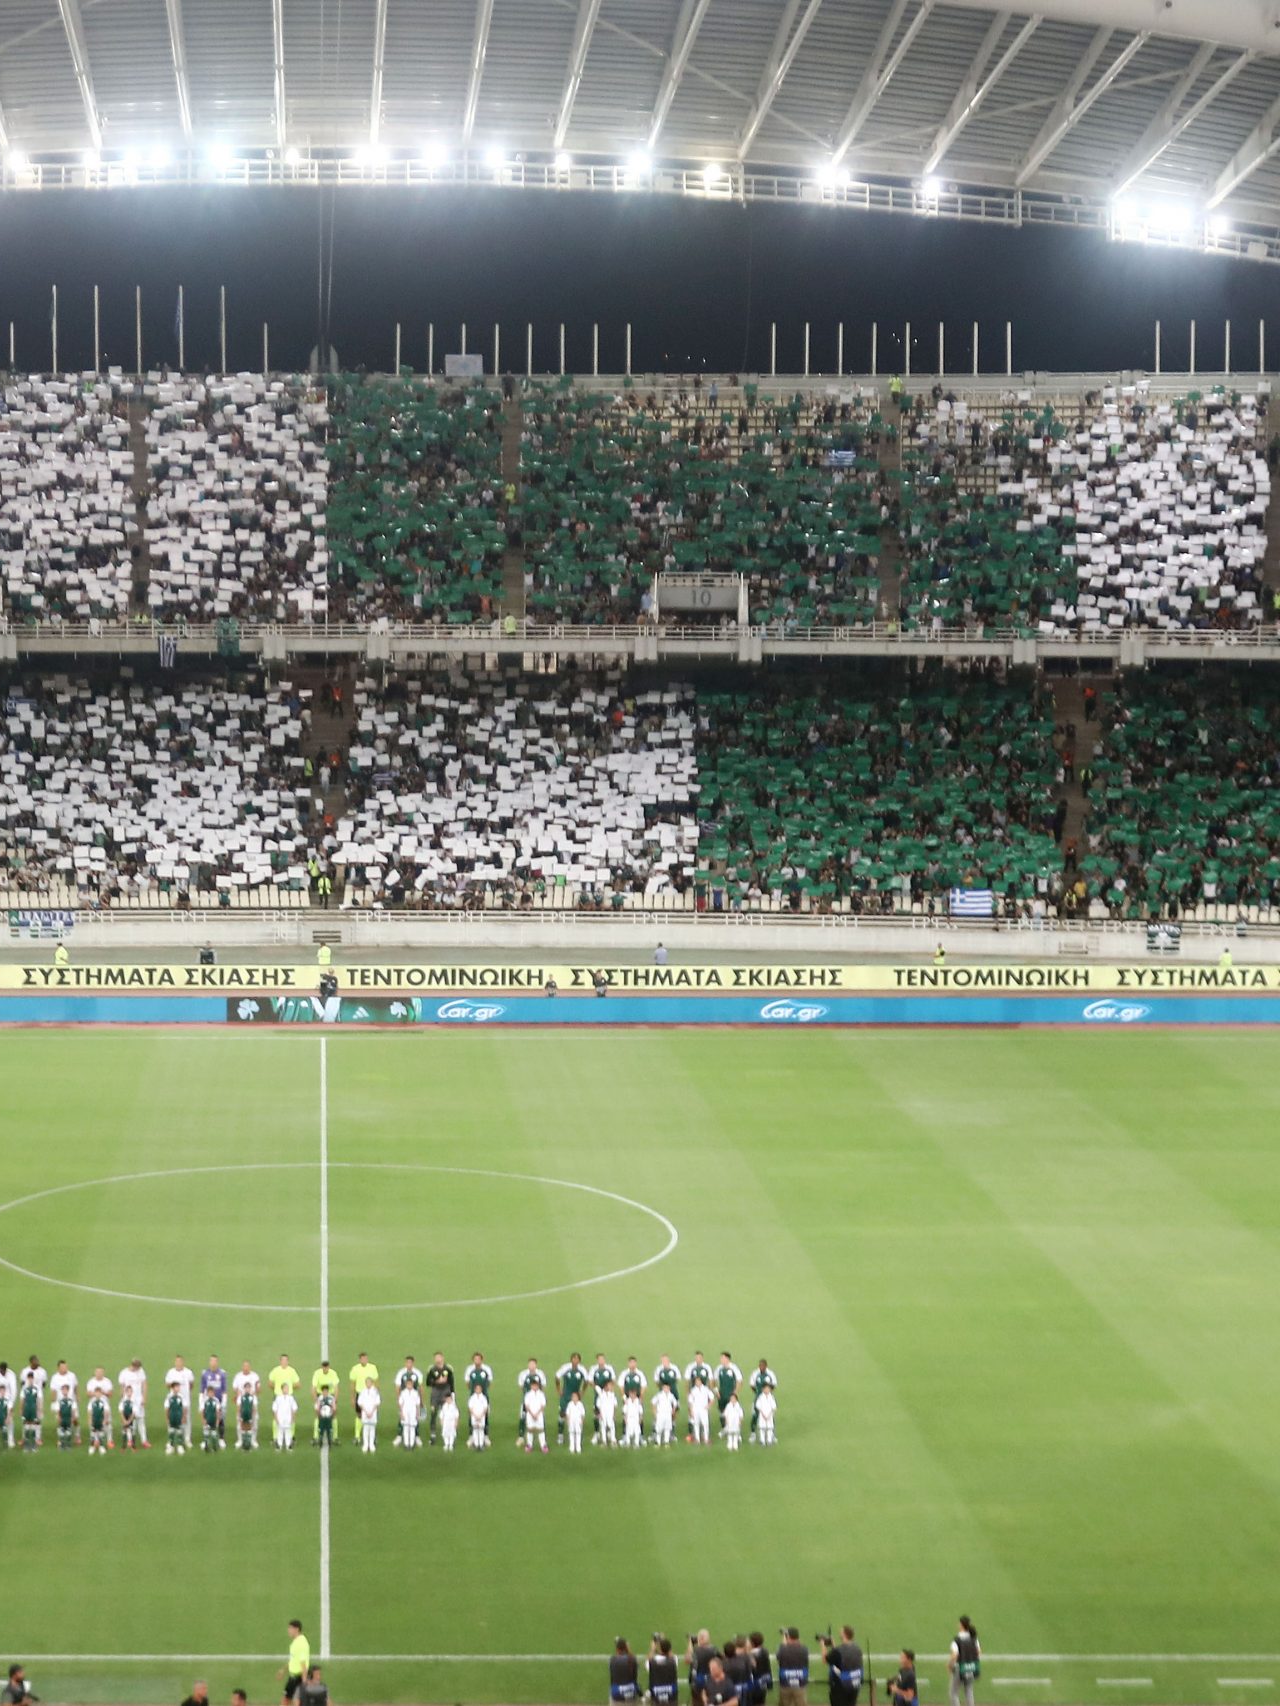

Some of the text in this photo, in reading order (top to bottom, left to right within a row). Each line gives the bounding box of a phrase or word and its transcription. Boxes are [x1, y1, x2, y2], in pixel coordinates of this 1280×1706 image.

[692, 589, 712, 607] 10
[22, 967, 176, 986] ΣΥΣΤΗΜΑΤΑ
[184, 967, 296, 986] ΣΚΙΑΣΗΣ
[346, 967, 544, 986] ΤΕΝΤΟΜΙΝΩΙΚΗ
[732, 968, 843, 986] ΣΚΙΑΣΗΣ
[893, 968, 1090, 987] ΤΕΝΤΟΜΙΝΩΙΚΗ
[1116, 968, 1268, 987] ΣΥΣΤΗΜΑΤΑ
